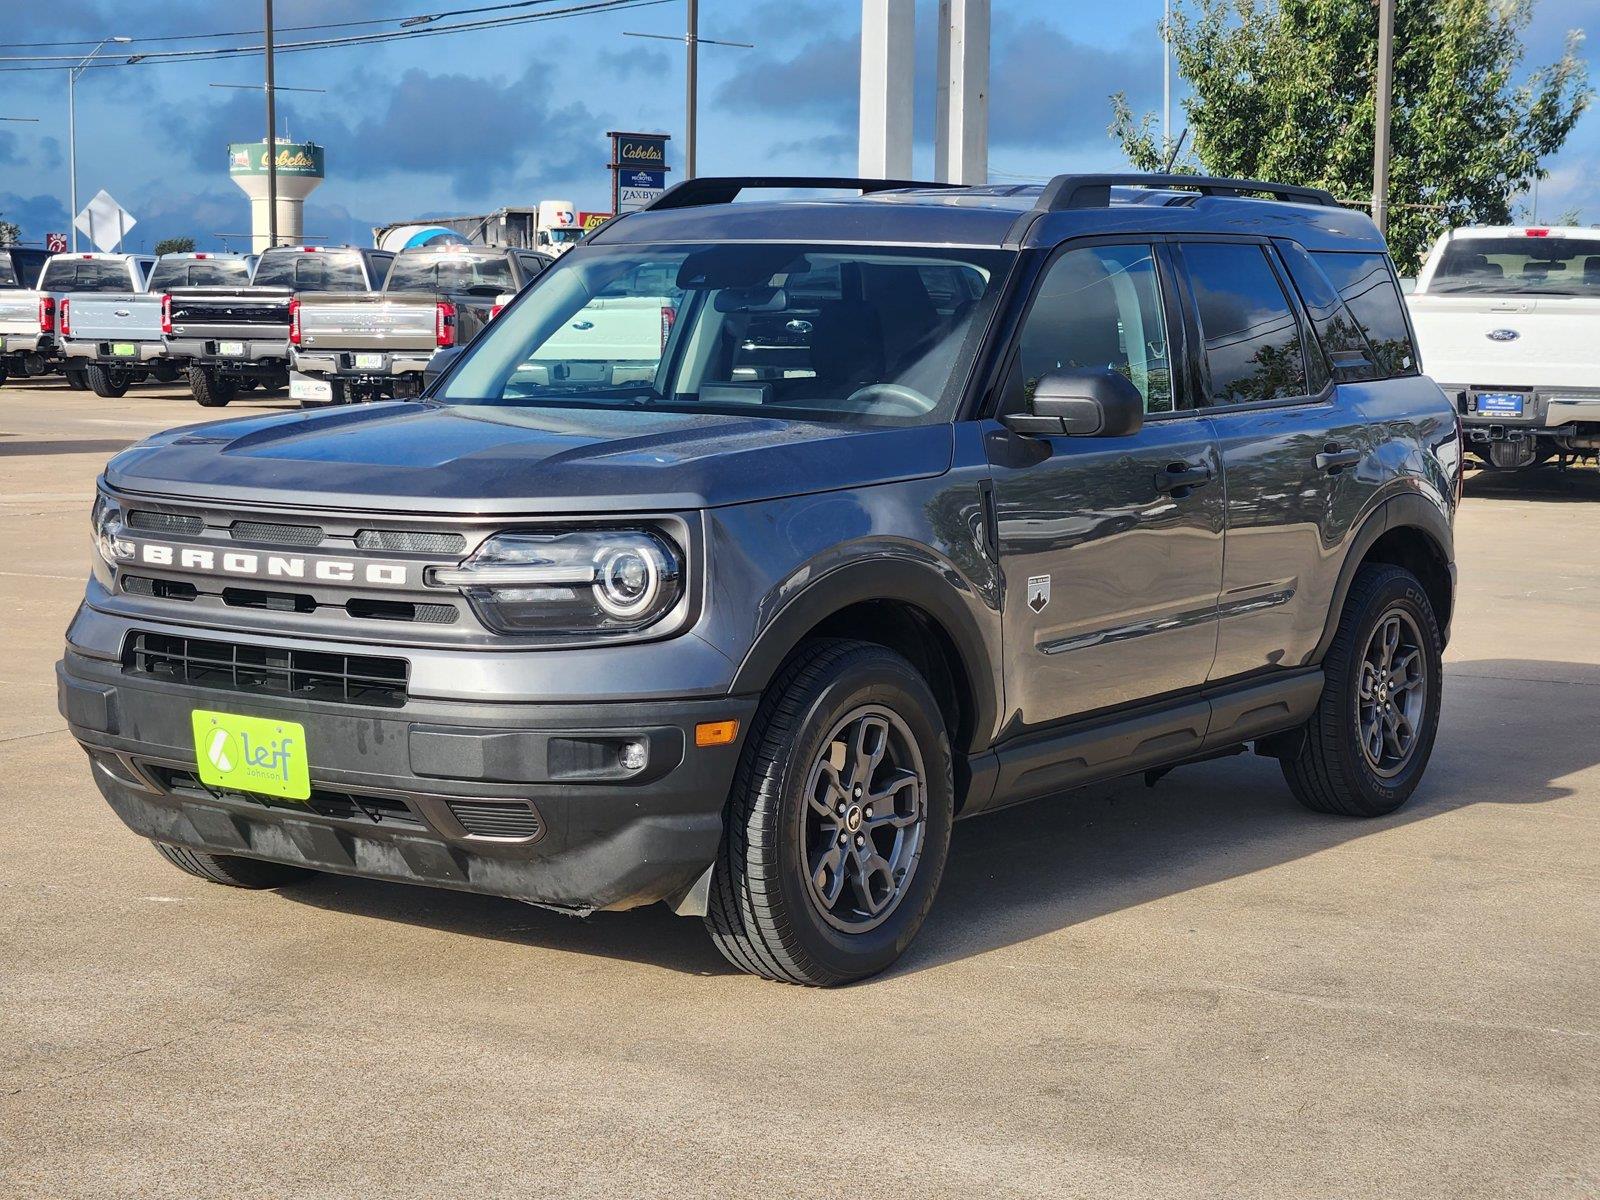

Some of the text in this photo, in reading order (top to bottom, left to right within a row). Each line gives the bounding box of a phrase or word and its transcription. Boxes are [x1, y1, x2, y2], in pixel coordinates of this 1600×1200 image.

[261, 149, 314, 167] Cbela's
[623, 143, 662, 160] Cabela's
[143, 544, 407, 585] BRONCO
[246, 768, 281, 781] Johnson
